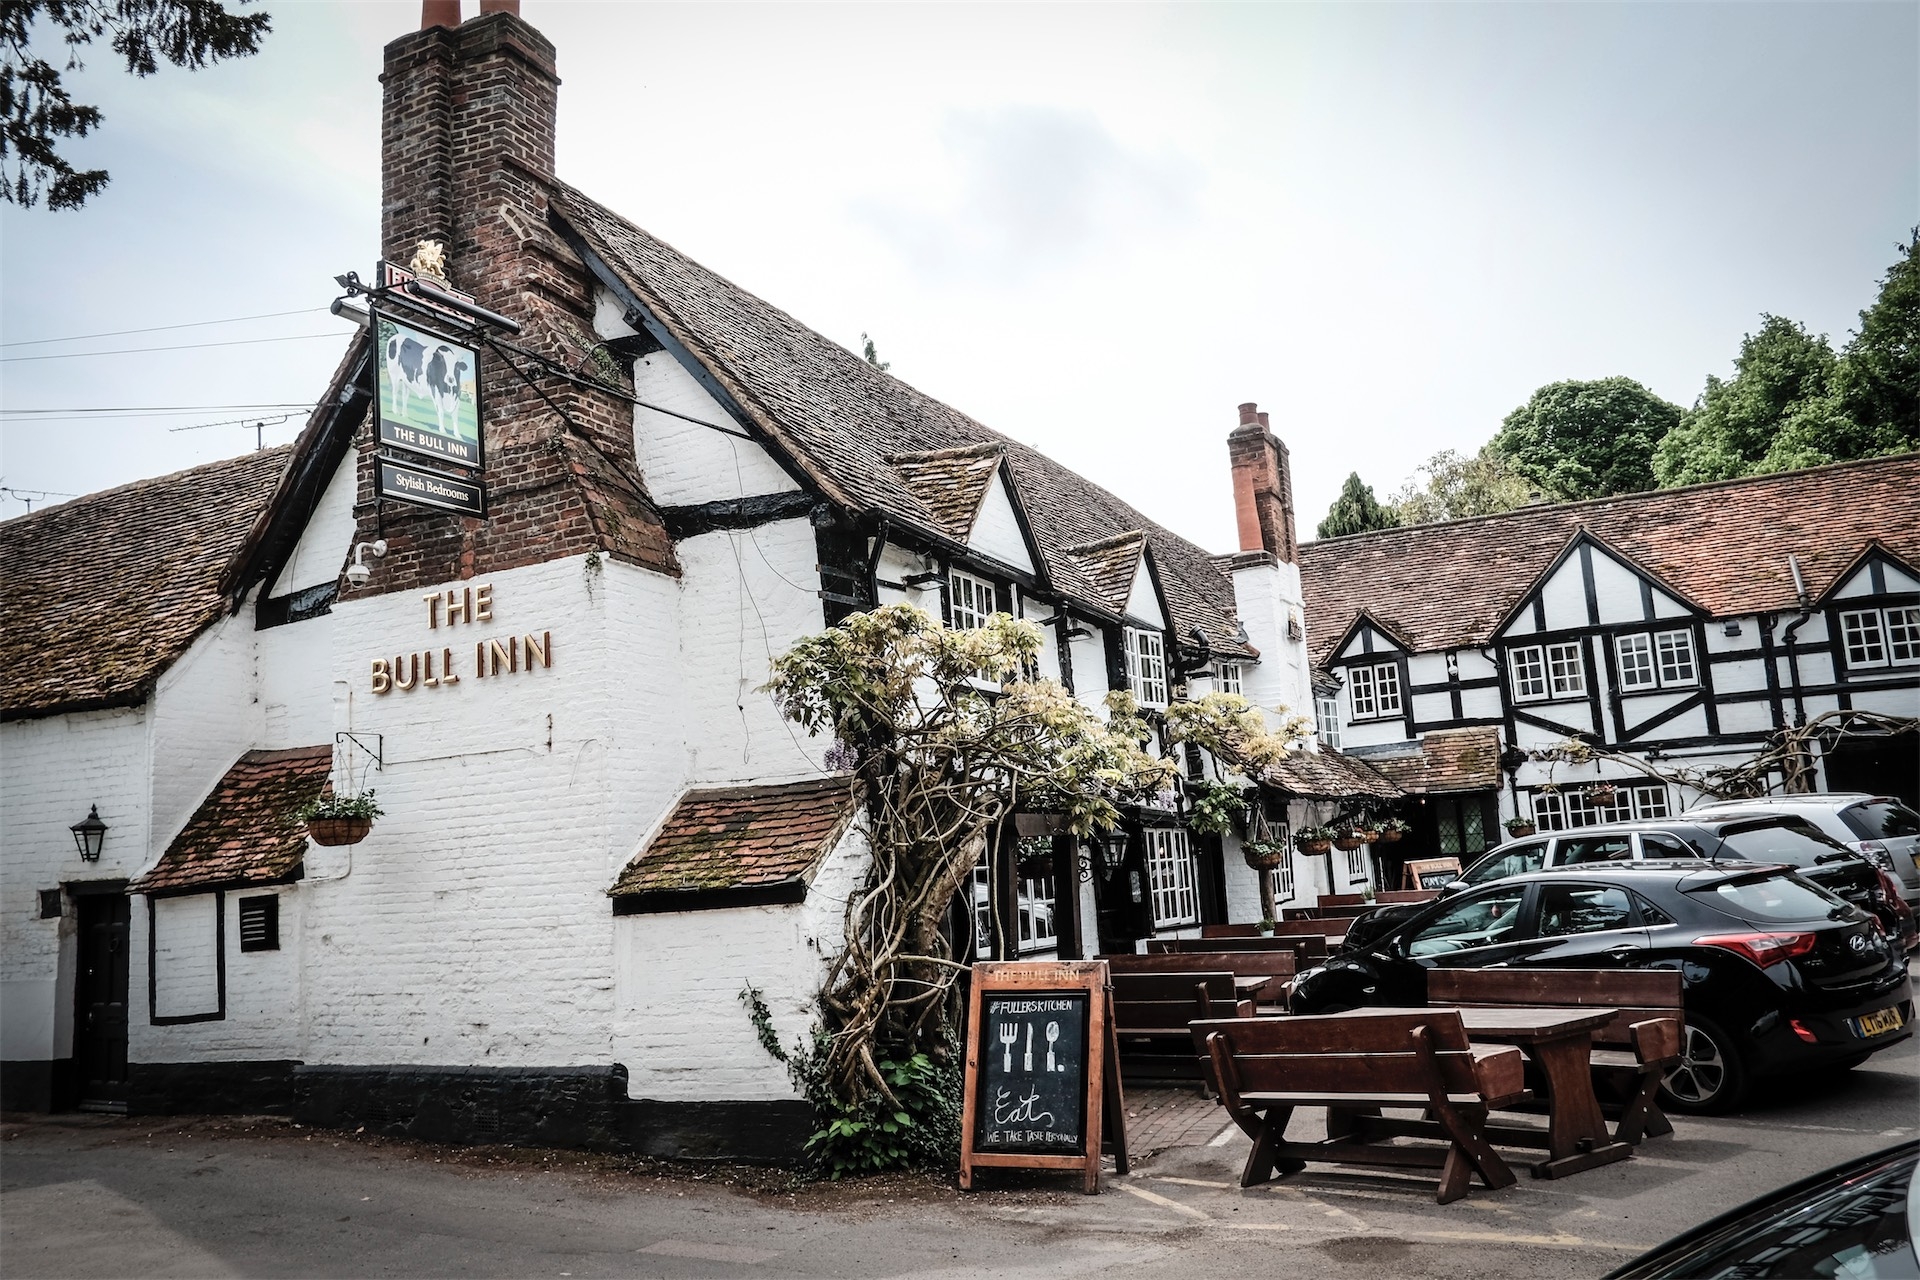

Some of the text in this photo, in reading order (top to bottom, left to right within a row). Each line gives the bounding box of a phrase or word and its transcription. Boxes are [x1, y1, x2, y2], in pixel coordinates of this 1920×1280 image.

[394, 427, 468, 457] THE BULL INN
[396, 474, 469, 501] Stylish Bedrooms
[423, 583, 493, 629] THE
[371, 631, 550, 694] BULL INN
[994, 969, 1079, 981] THE BULL INN
[994, 1084, 1055, 1127] Eat
[987, 1130, 1000, 1142] WE
[1003, 1130, 1022, 1142] TAKE
[1025, 1130, 1044, 1142] TASTE
